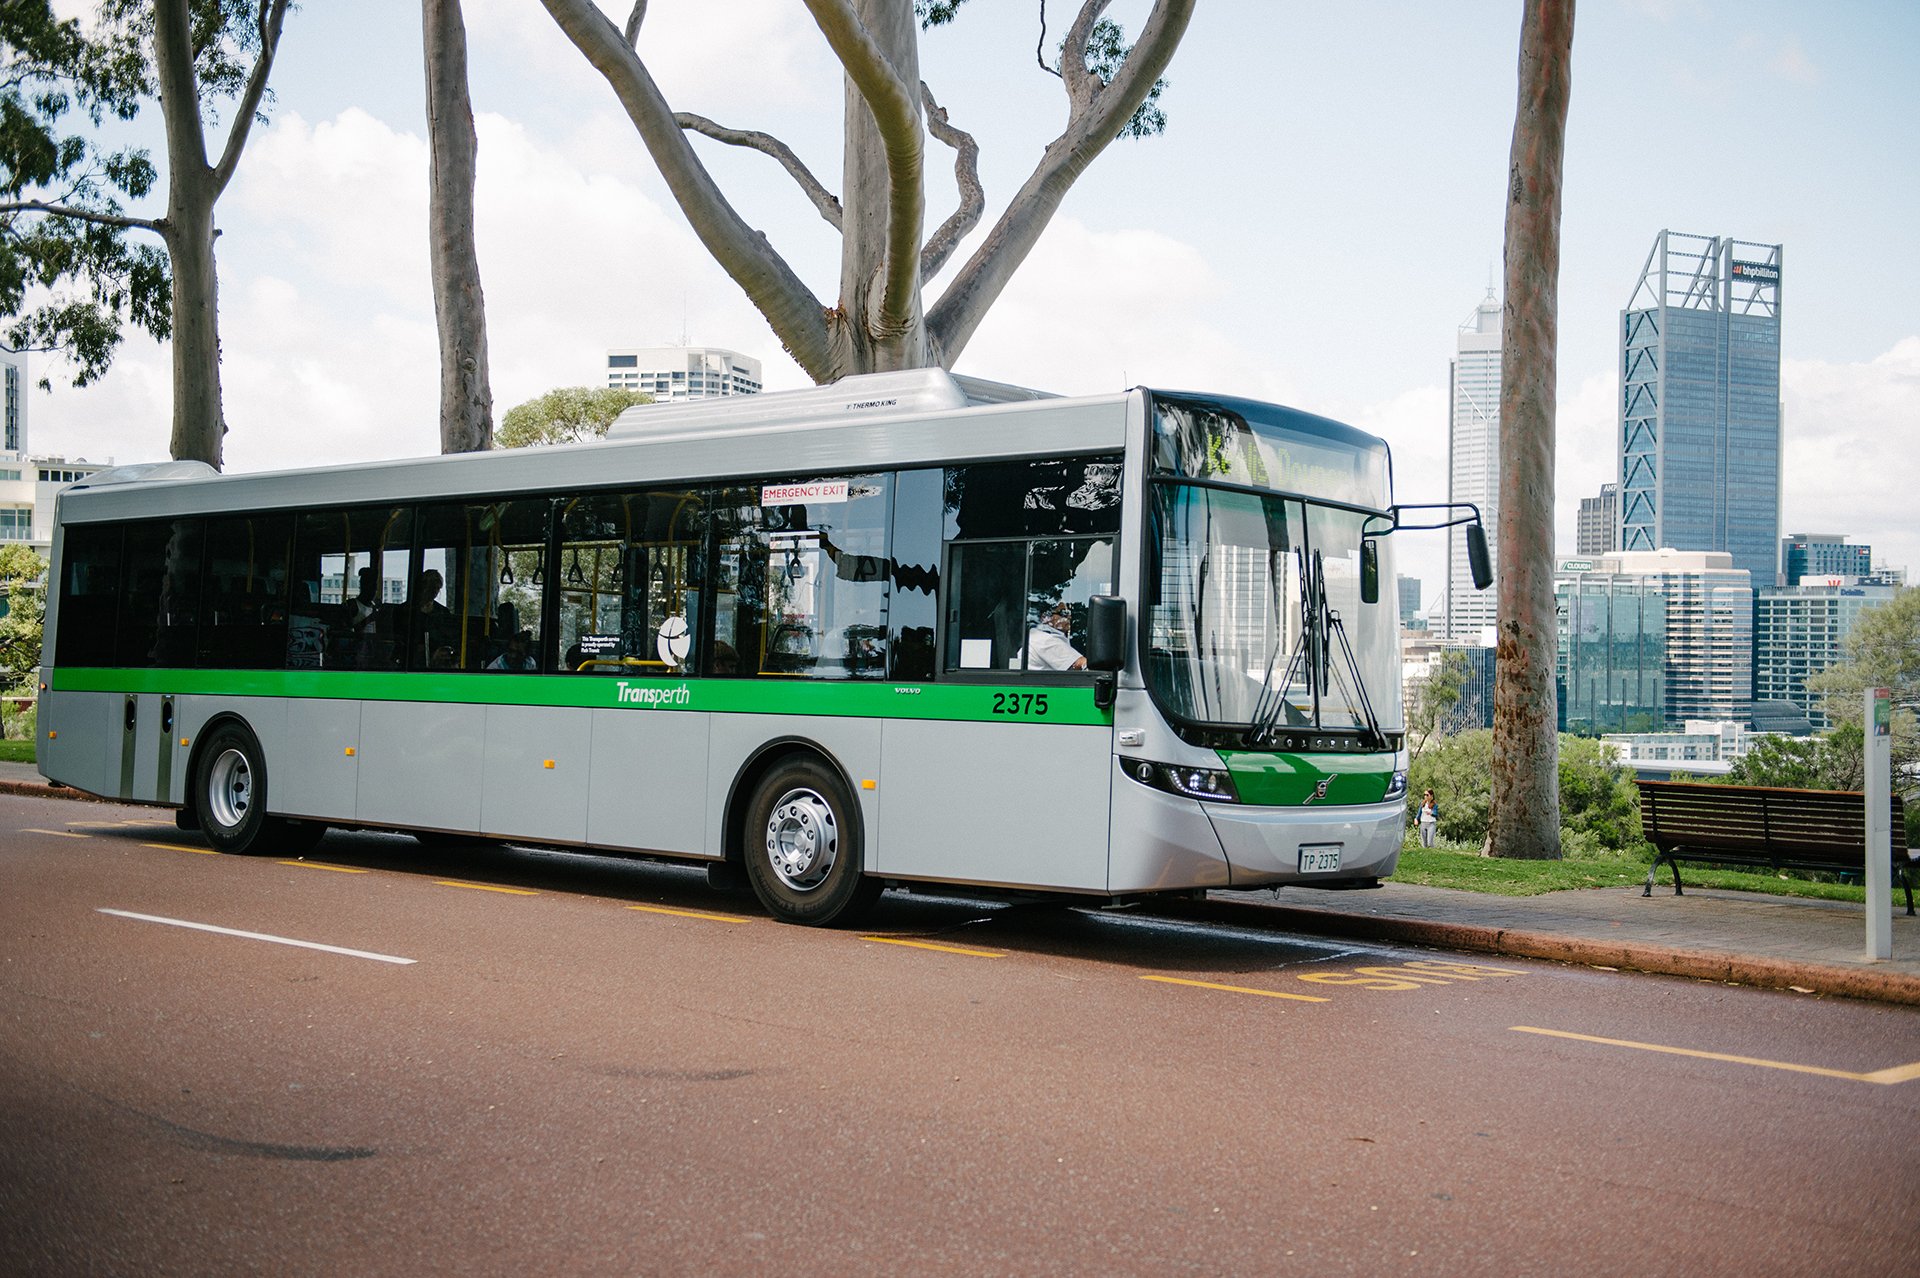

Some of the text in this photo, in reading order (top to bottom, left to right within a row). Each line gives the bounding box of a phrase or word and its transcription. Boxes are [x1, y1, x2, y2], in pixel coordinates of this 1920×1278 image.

[853, 401, 880, 409] THERMO
[1207, 433, 1268, 484] Kelis
[763, 485, 846, 499] EMERGENCY EXIT
[617, 682, 690, 709] Transperth
[894, 687, 921, 695] VOLVO
[992, 693, 1049, 716] 2375
